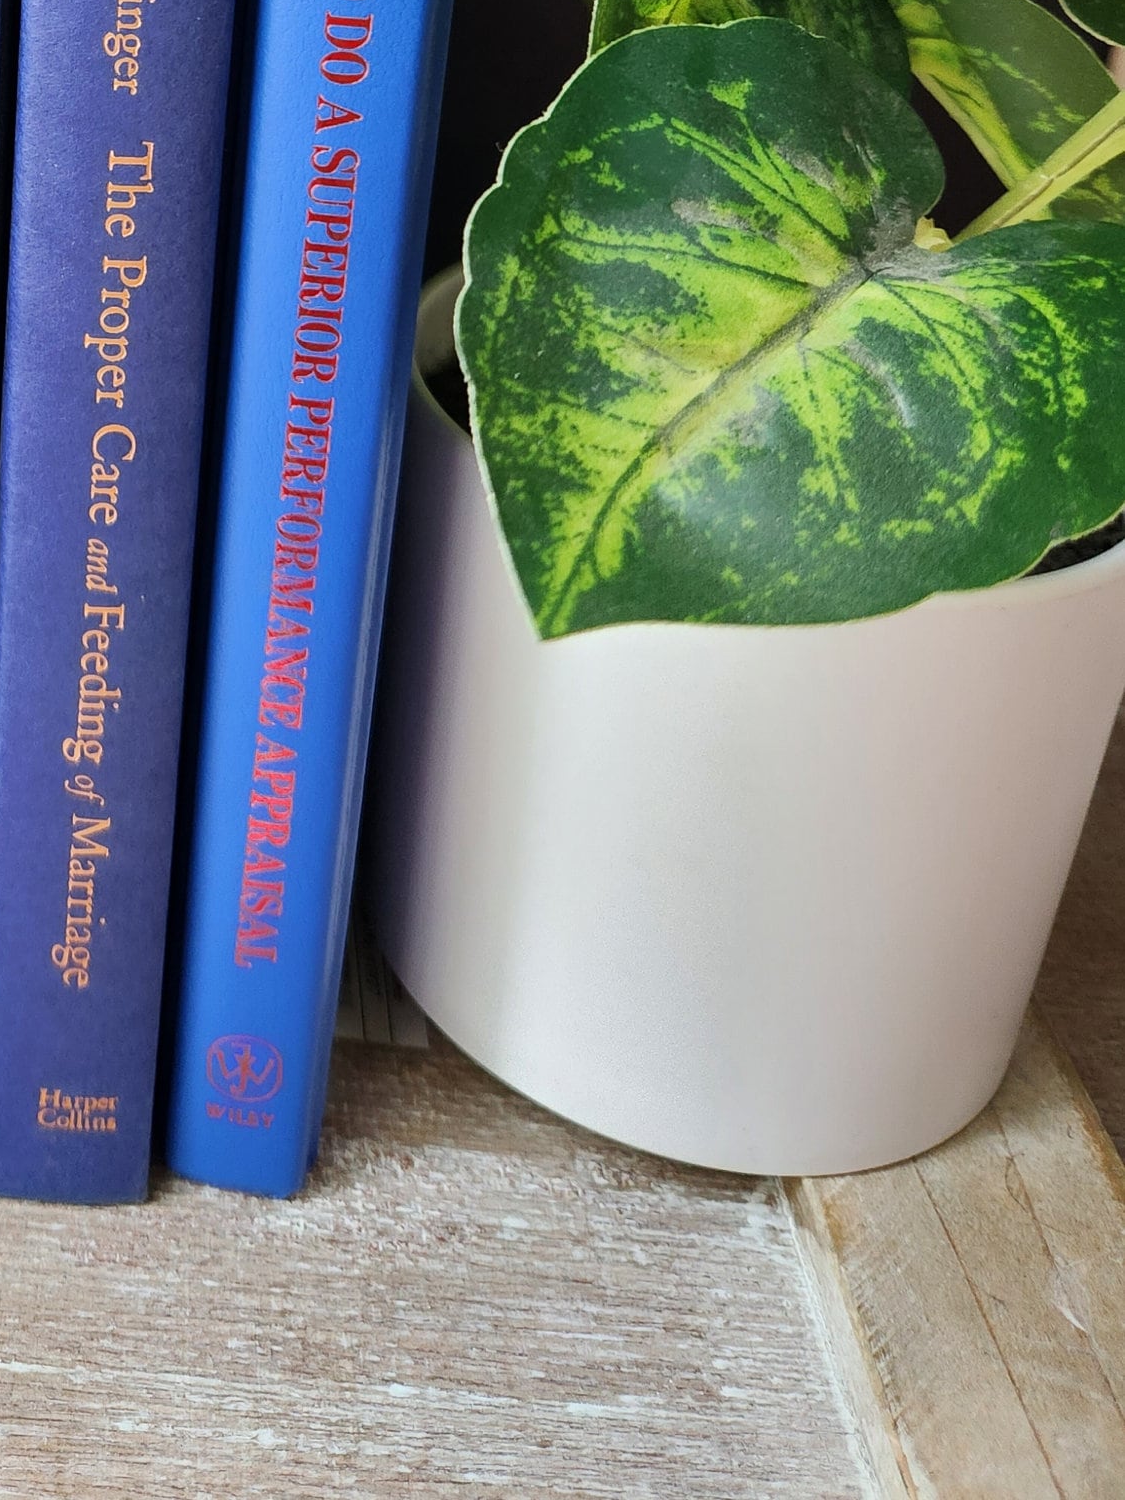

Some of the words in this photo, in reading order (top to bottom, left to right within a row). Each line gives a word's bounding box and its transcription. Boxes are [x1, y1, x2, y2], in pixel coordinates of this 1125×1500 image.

[320, 12, 374, 85] DO
[315, 95, 362, 134] A
[104, 141, 154, 237] The
[292, 146, 362, 385] SUPERIOR
[84, 255, 148, 409] Proper
[89, 423, 136, 526] Care
[86, 540, 118, 595] and
[259, 392, 334, 729] PERFORMANCE
[63, 602, 125, 765] Feeding
[65, 776, 104, 807] of
[235, 734, 296, 968] APPRAISAL
[51, 813, 111, 989] Marriage
[37, 1108, 117, 1131] Collins
[38, 1088, 118, 1112] Harper
